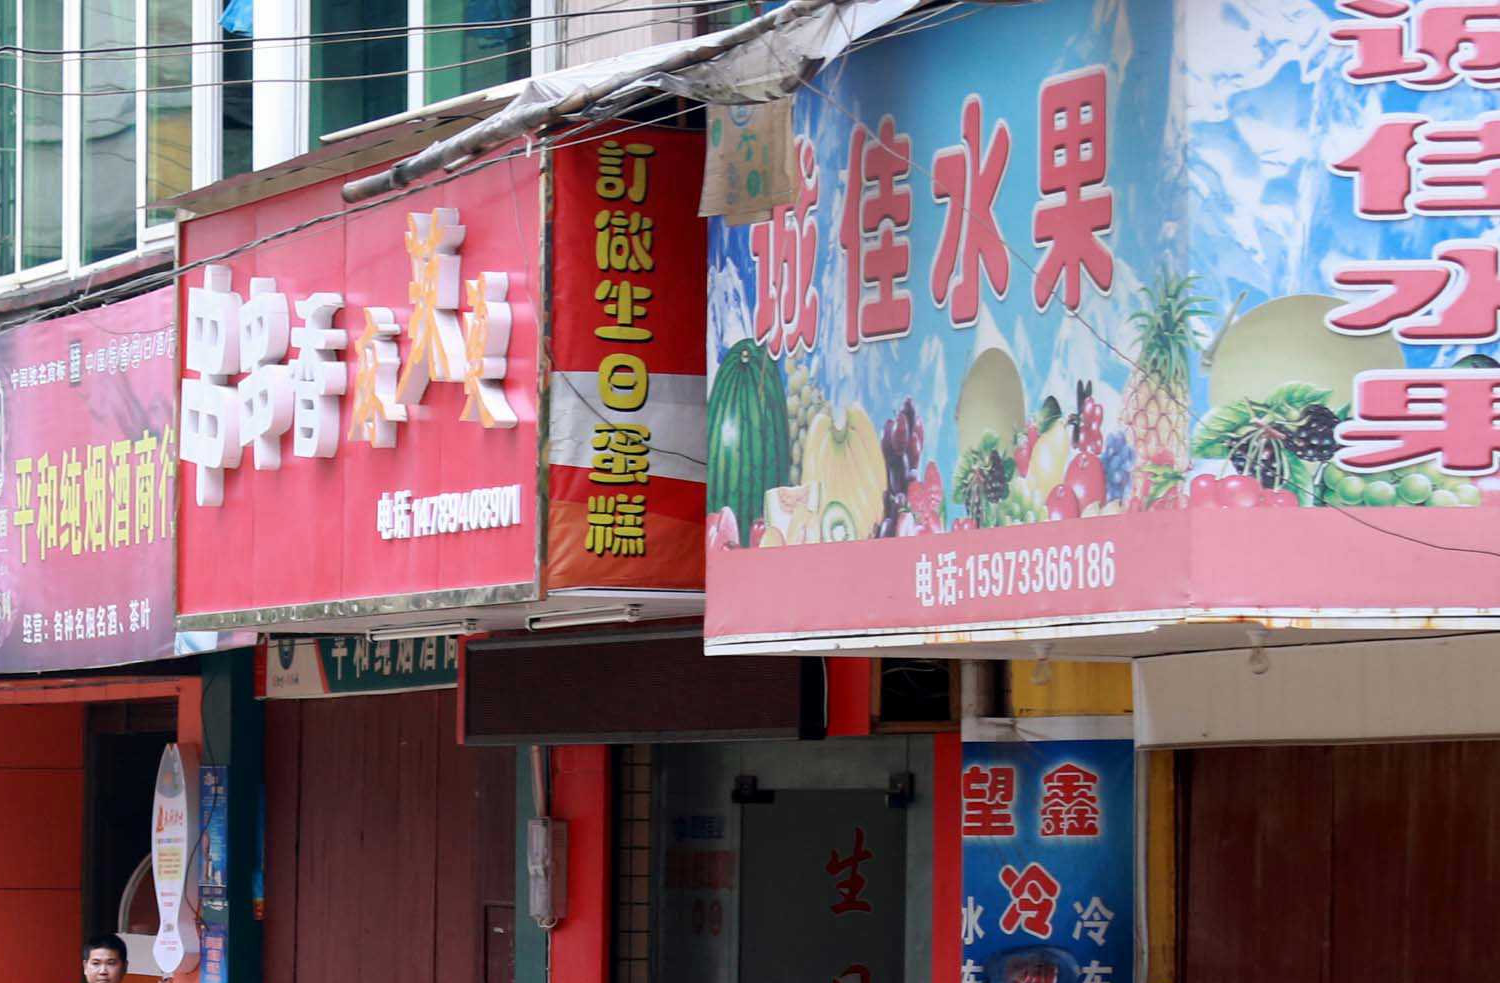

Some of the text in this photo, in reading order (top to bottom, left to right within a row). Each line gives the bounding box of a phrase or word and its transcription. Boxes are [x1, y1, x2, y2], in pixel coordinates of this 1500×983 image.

[585, 140, 656, 558] 訂做生日蛋糕
